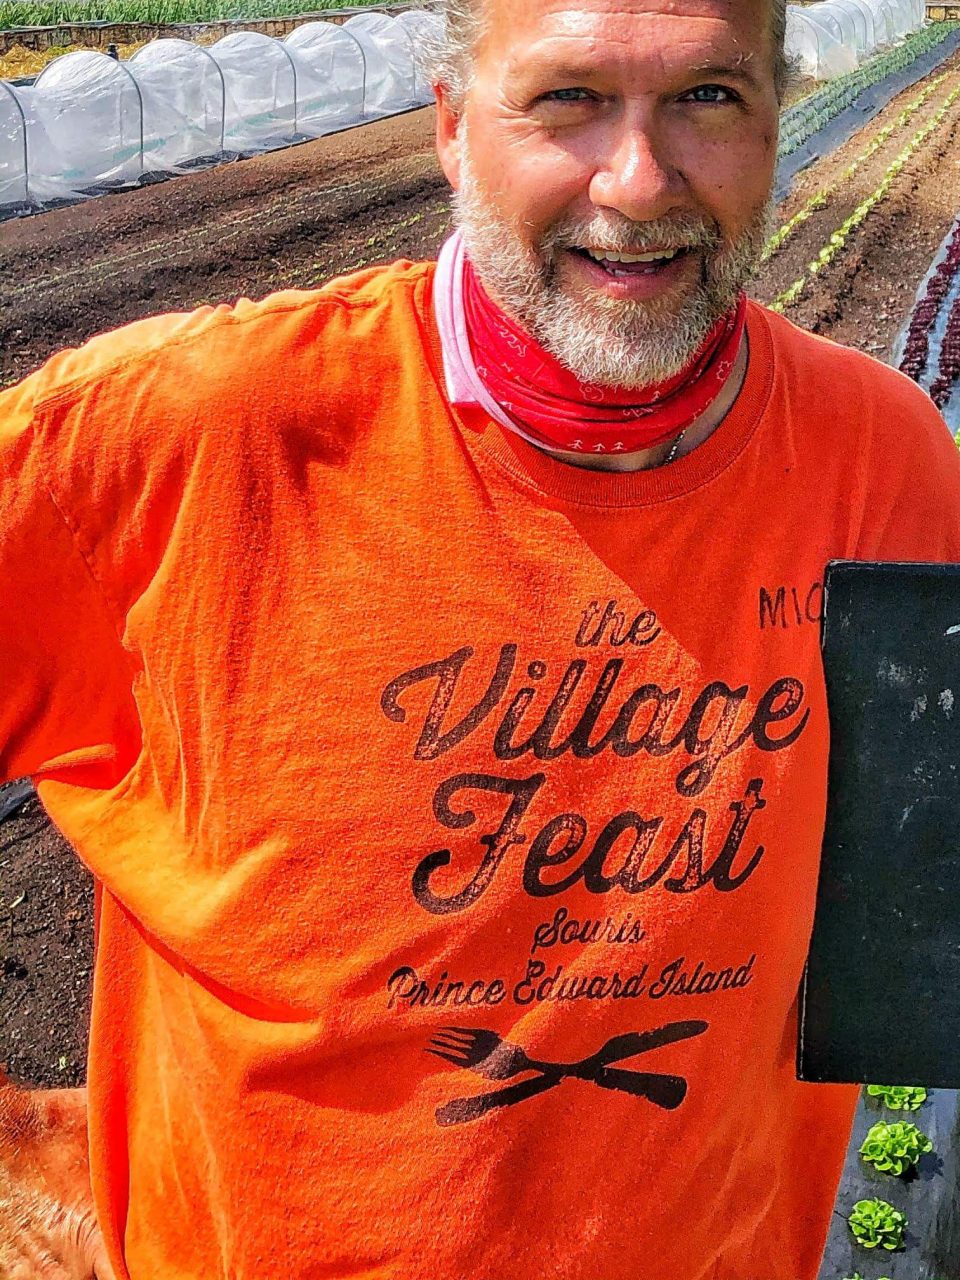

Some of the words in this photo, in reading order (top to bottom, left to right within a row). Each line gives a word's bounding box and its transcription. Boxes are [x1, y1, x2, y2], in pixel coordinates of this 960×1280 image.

[574, 599, 661, 646] the
[379, 643, 811, 797] Village
[411, 772, 765, 915] Feast
[532, 908, 645, 952] Souris
[387, 964, 507, 1011] Prince
[513, 956, 645, 1006] Edward
[648, 954, 754, 1000] Island
